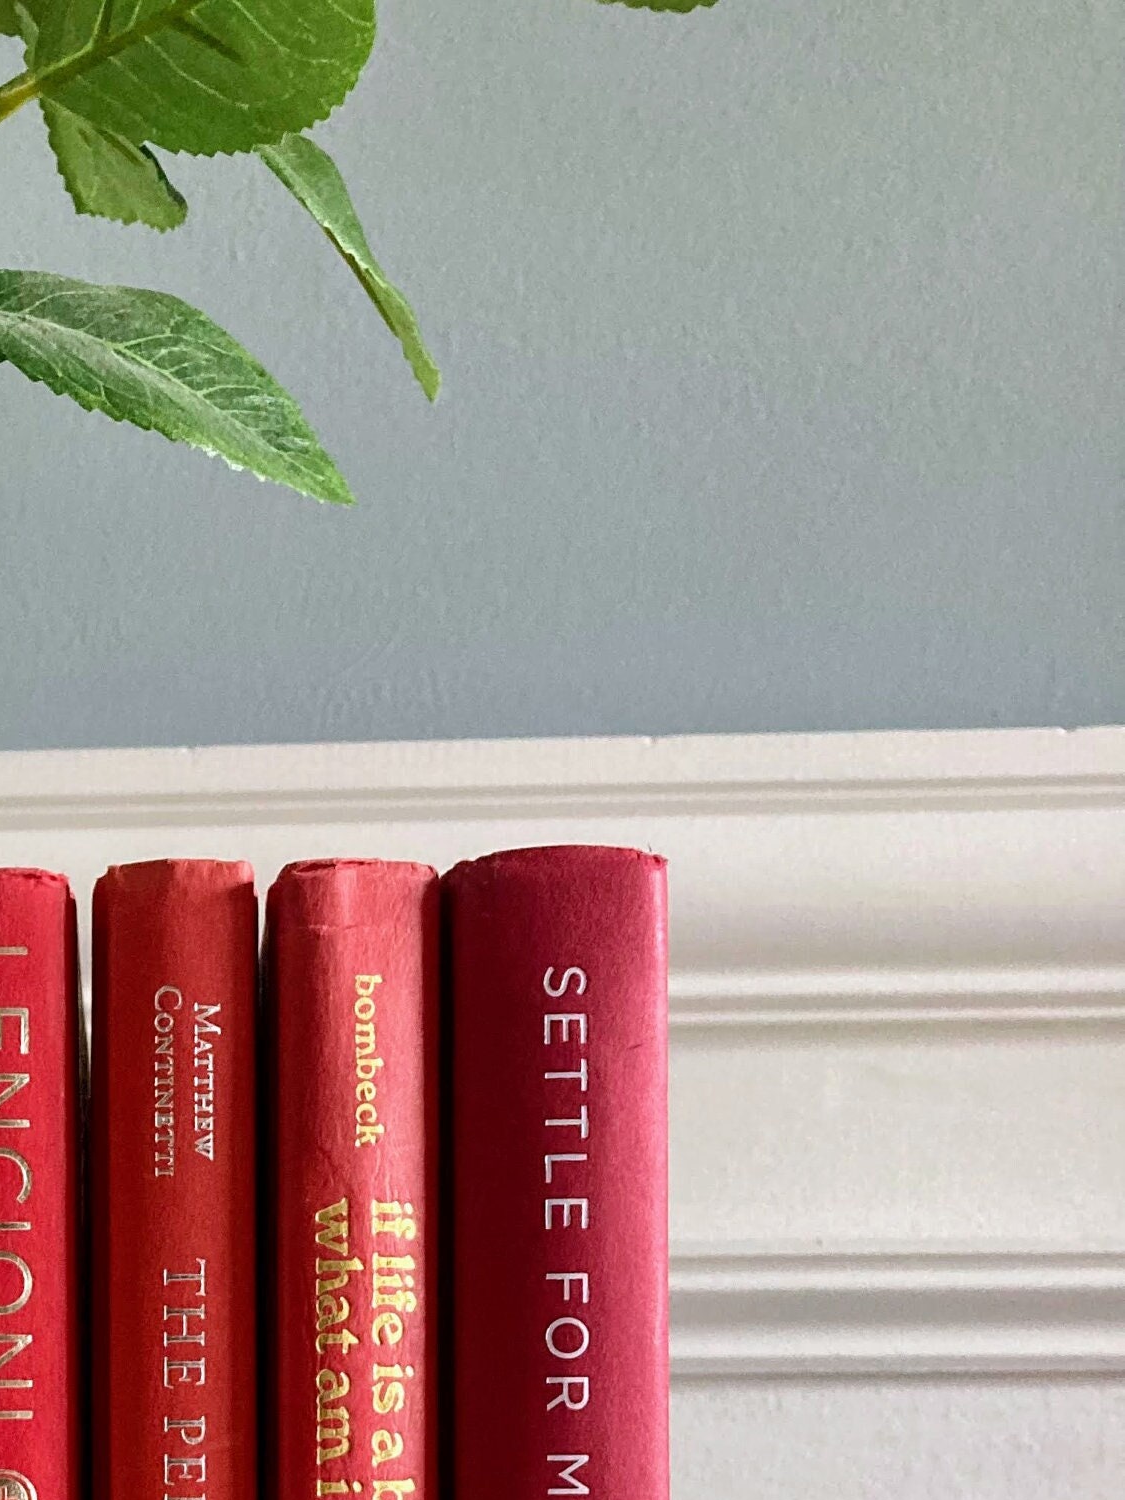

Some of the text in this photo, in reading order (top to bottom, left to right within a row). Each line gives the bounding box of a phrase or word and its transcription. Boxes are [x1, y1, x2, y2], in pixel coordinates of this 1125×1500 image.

[354, 974, 385, 1148] bombeck
[542, 966, 590, 1230] SETTLE
[370, 1198, 417, 1241] if
[163, 1257, 207, 1389] THE
[314, 1197, 365, 1356] what
[371, 1252, 418, 1348] life
[371, 1363, 415, 1414] is
[545, 1272, 590, 1411] FOR
[315, 1368, 350, 1466] am
[371, 1429, 404, 1468] a
[316, 1479, 363, 1498] i
